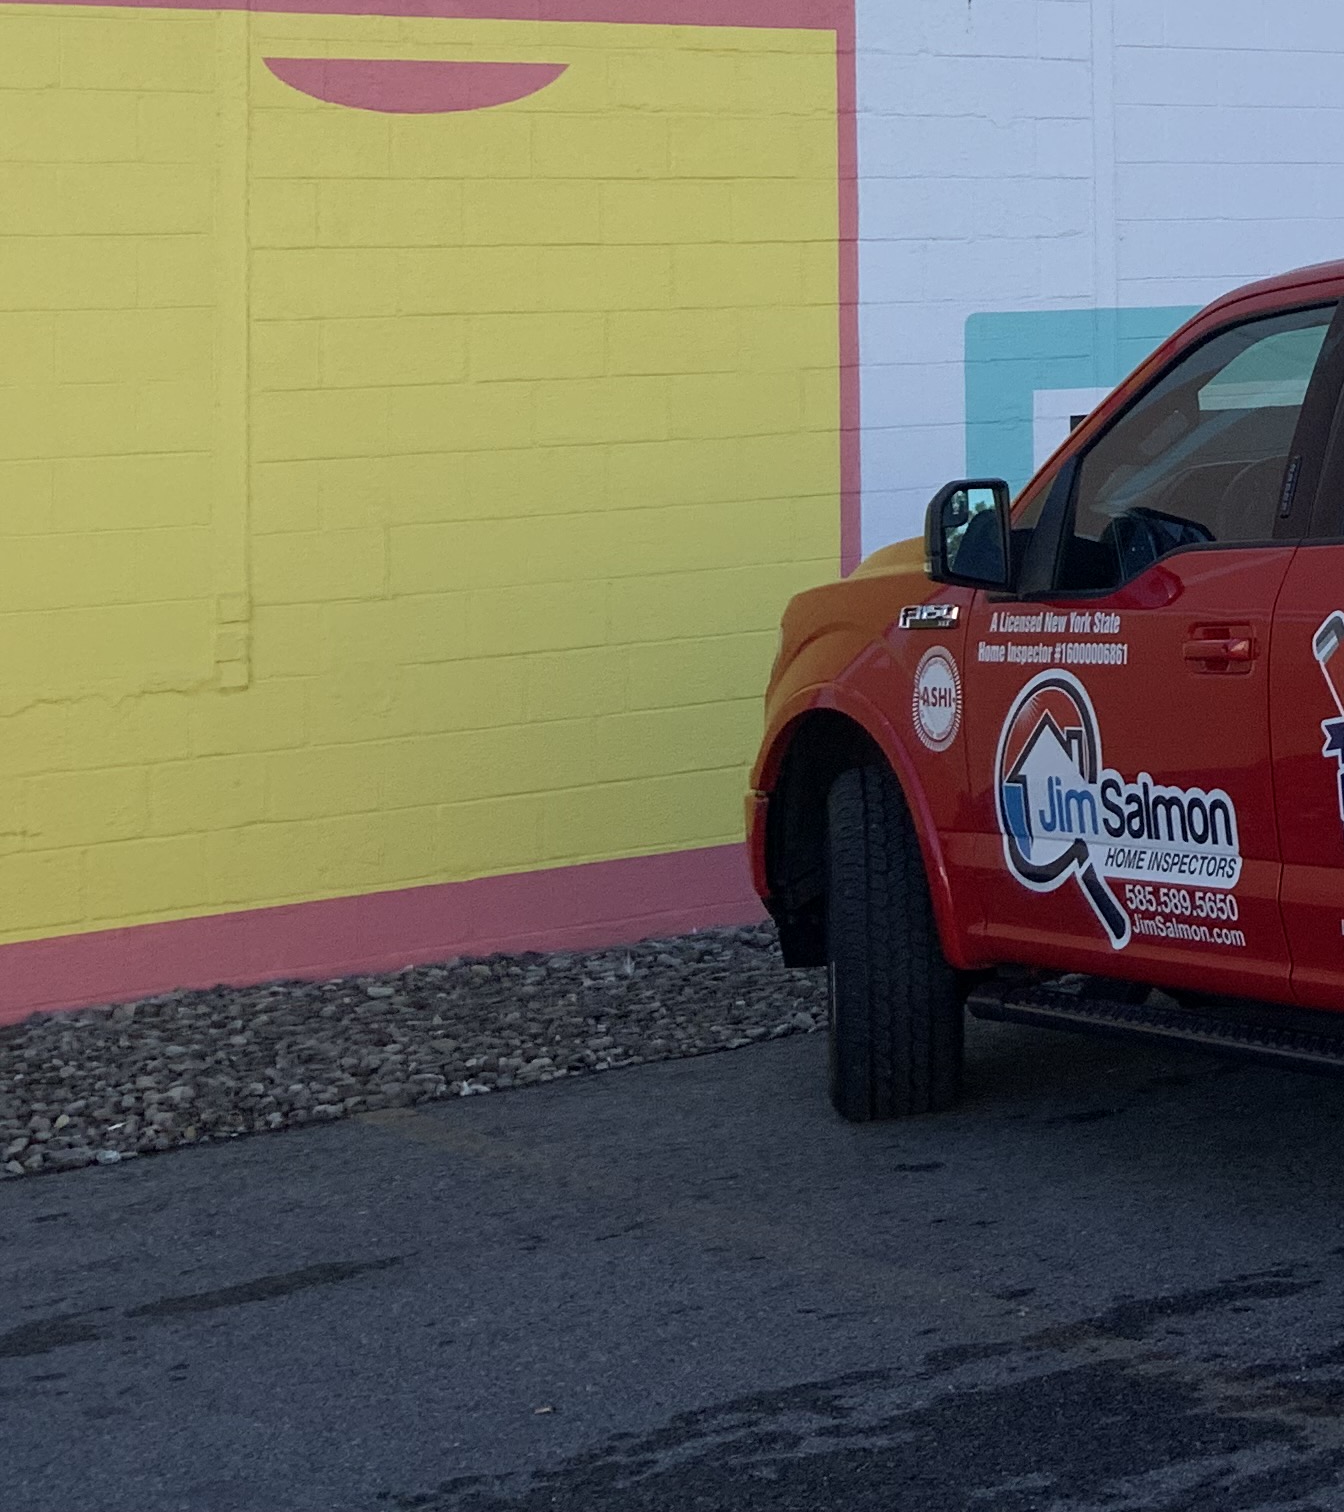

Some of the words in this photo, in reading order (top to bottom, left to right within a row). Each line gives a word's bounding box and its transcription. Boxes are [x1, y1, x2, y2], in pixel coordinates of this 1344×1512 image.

[989, 611, 998, 633] A
[999, 611, 1044, 633] Licensed
[1043, 611, 1068, 633] New
[1069, 611, 1092, 633] York
[1093, 611, 1121, 634] State
[978, 641, 1006, 662] Home
[1007, 641, 1053, 666] Inspector
[922, 686, 952, 708] ASHI
[1039, 775, 1099, 835] Jim
[1100, 778, 1234, 847] Salmon
[1104, 847, 1146, 870] HOME
[1147, 850, 1237, 879] INSPECTORS
[1125, 884, 1239, 921] 585.589.5650
[1132, 913, 1246, 947] JimSalmon.com
